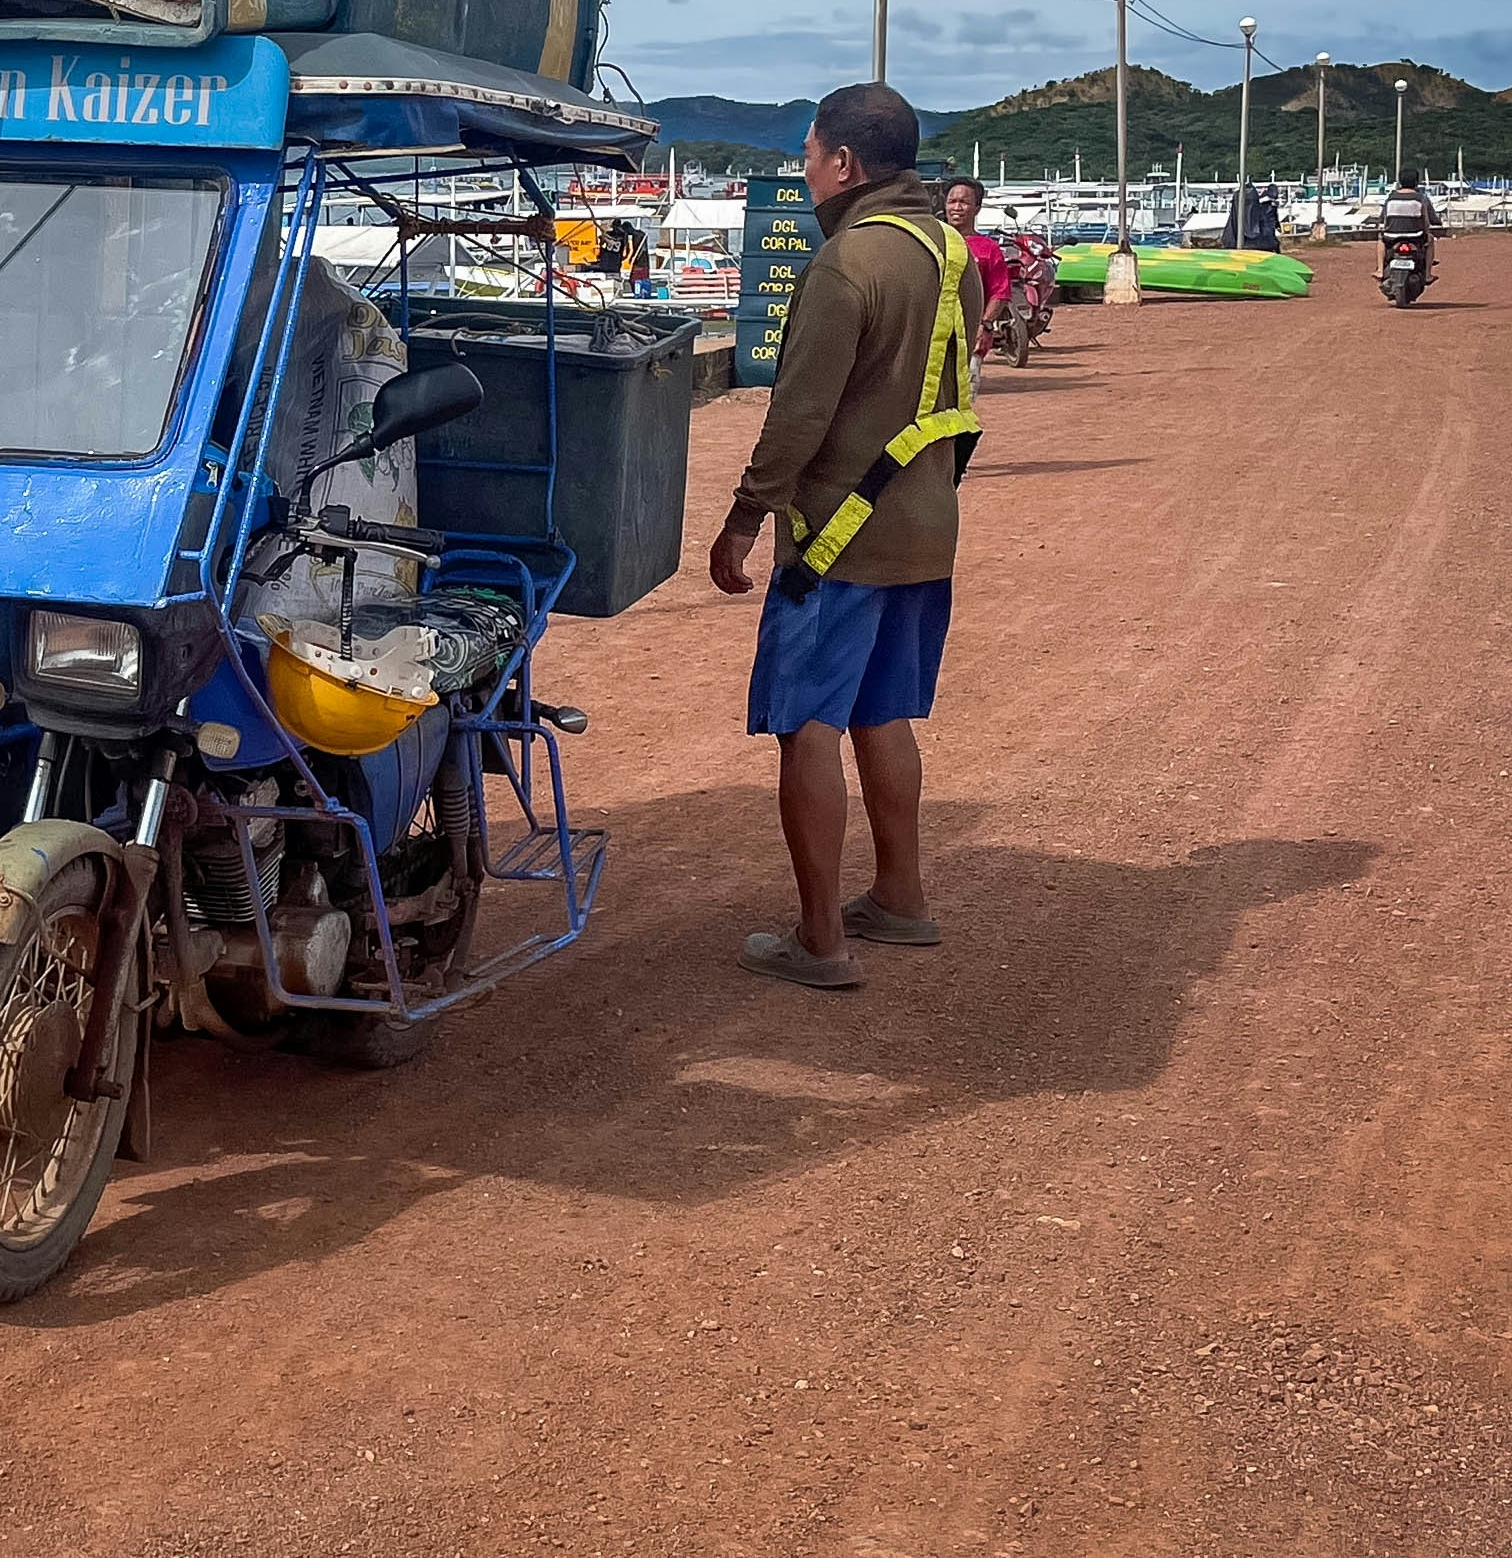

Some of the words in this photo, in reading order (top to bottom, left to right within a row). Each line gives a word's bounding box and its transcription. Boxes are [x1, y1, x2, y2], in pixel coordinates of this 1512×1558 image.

[45, 54, 228, 127] Kaizer
[776, 188, 804, 202] DGL
[772, 219, 799, 233] DGL
[761, 236, 787, 250] COR
[788, 238, 812, 251] PAL
[769, 265, 796, 279] DGL
[767, 304, 787, 317] DG
[764, 329, 782, 343] DG
[303, 352, 326, 434] VIETNAM
